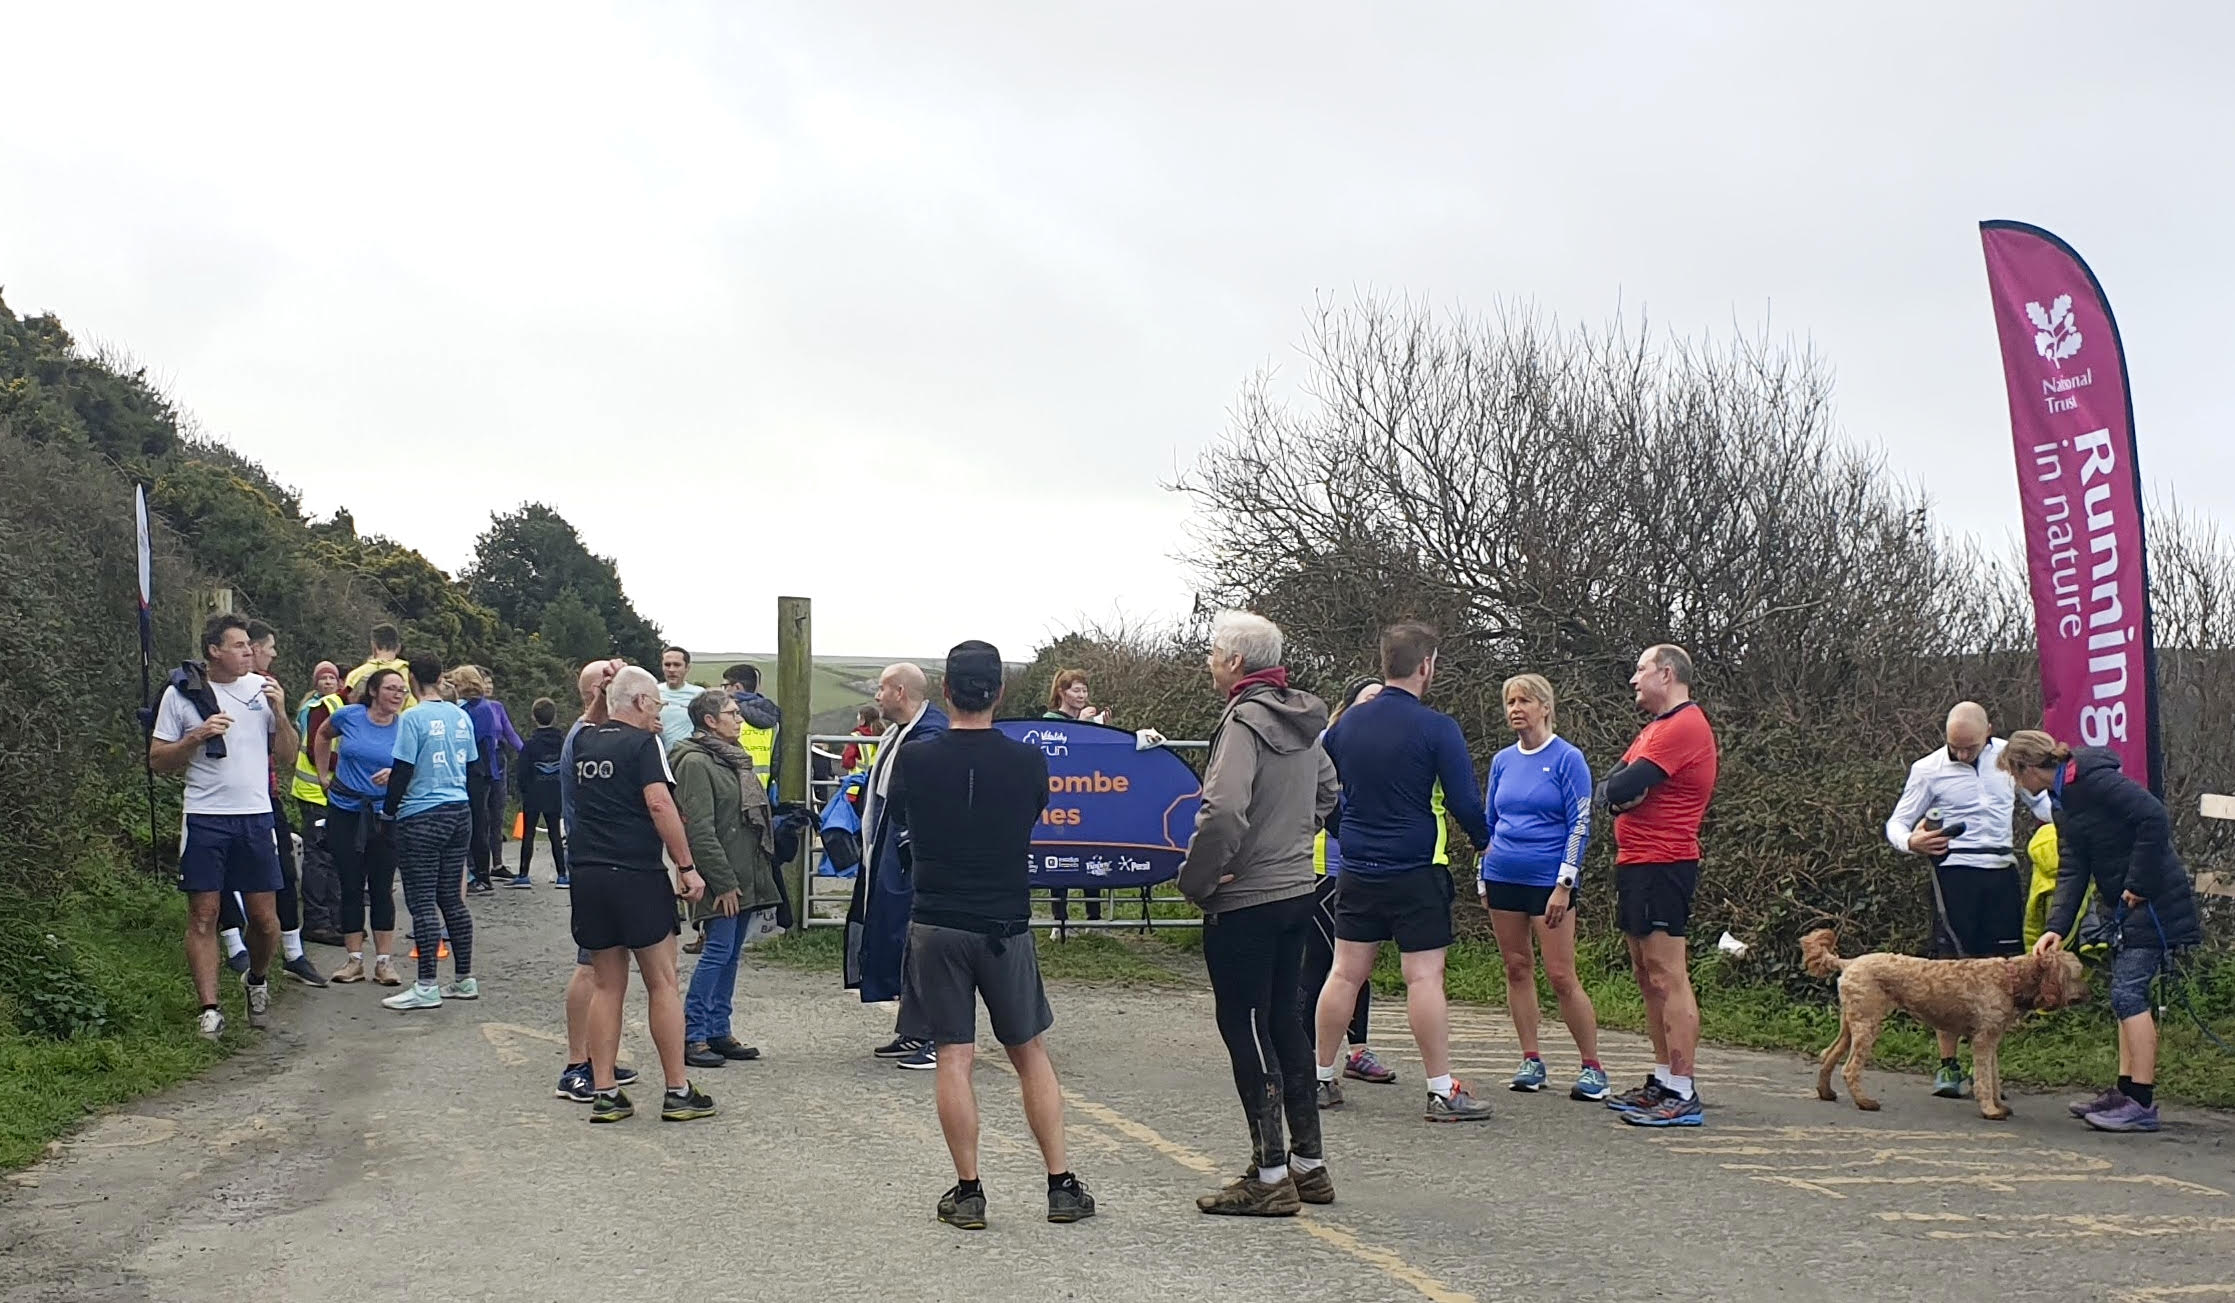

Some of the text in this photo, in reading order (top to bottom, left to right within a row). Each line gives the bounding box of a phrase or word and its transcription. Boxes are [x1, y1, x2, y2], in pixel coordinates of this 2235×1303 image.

[2042, 367, 2092, 395] National
[2044, 395, 2078, 414] Trust
[2034, 439, 2082, 639] in nature
[2074, 428, 2134, 747] Running
[1040, 745, 1068, 757] run
[576, 760, 614, 784] 100
[1048, 770, 1129, 793] ombe
